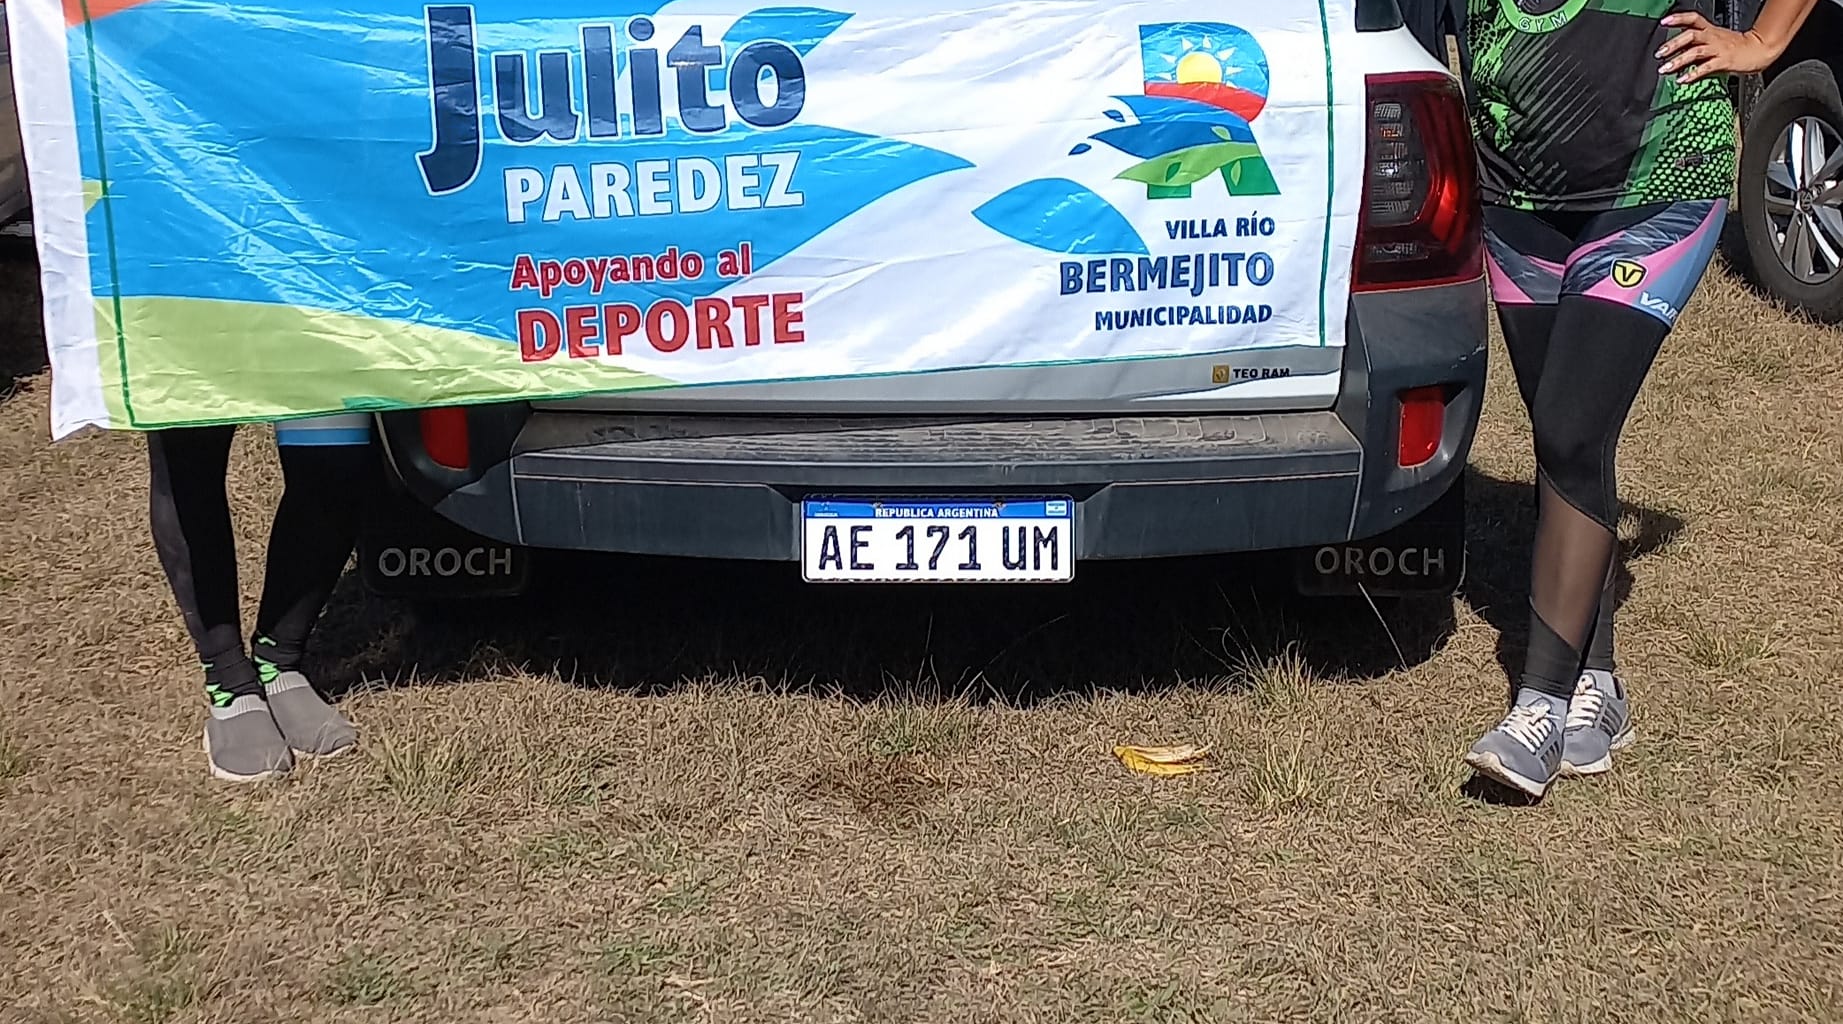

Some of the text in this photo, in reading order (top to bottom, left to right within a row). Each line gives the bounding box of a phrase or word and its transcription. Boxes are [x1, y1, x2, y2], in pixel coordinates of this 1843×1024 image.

[1519, 12, 1568, 30] GYM
[415, 4, 806, 195] Julito
[503, 150, 804, 224] PAREDEZ
[1165, 210, 1275, 240] VILLA RÍO
[510, 241, 753, 298] Apoyando al
[1059, 251, 1275, 297] BERMEJITO
[517, 292, 806, 363] DEPORTE
[1094, 304, 1273, 331] MUNICIPALIDAD
[1233, 368, 1291, 379] TEO RAM
[874, 507, 998, 518] REPUBLICA ARGENTINA
[378, 547, 511, 577] OROCH
[818, 525, 1058, 570] AE 171 UM
[1314, 546, 1445, 576] OROCH
